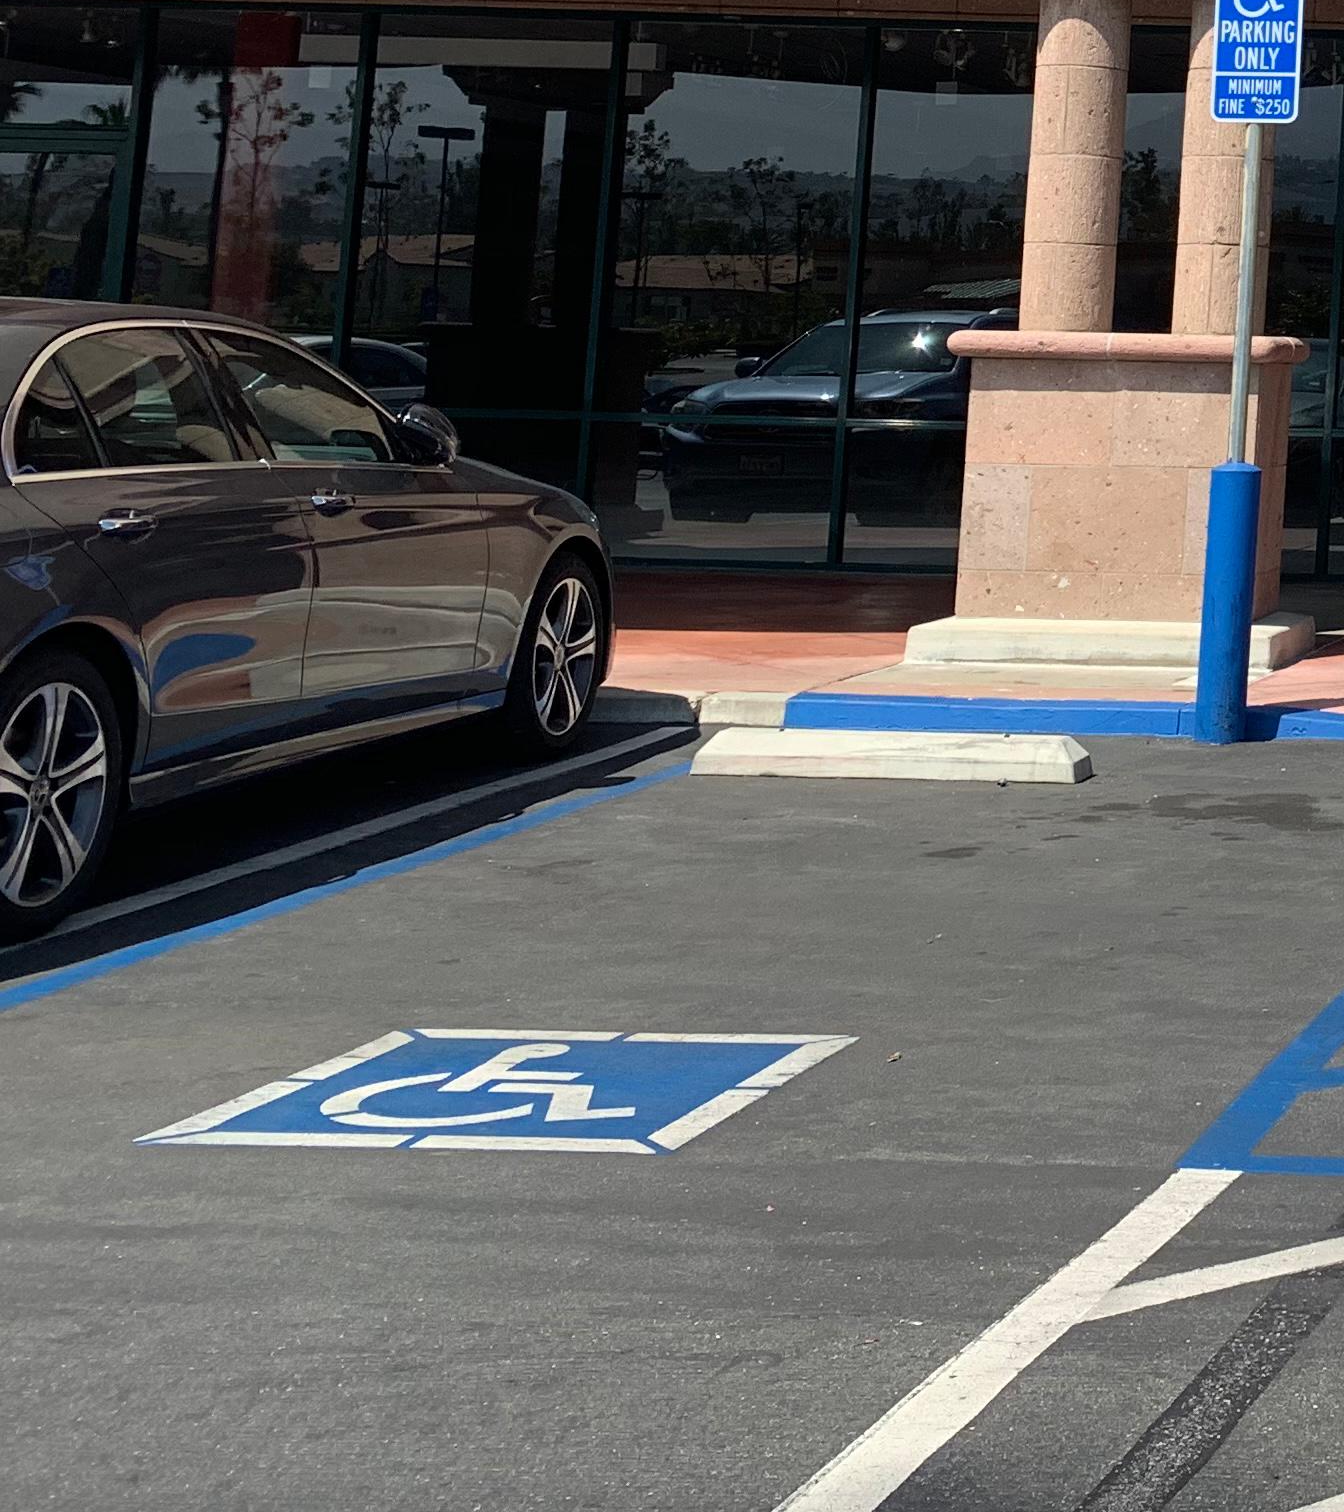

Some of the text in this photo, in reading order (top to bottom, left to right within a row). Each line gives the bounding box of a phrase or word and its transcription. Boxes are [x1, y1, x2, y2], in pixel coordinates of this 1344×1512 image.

[1220, 19, 1296, 44] PARKING
[1234, 46, 1281, 70] ONLY
[1228, 78, 1283, 96] MINIMUM
[1218, 97, 1291, 116] FINE $250
